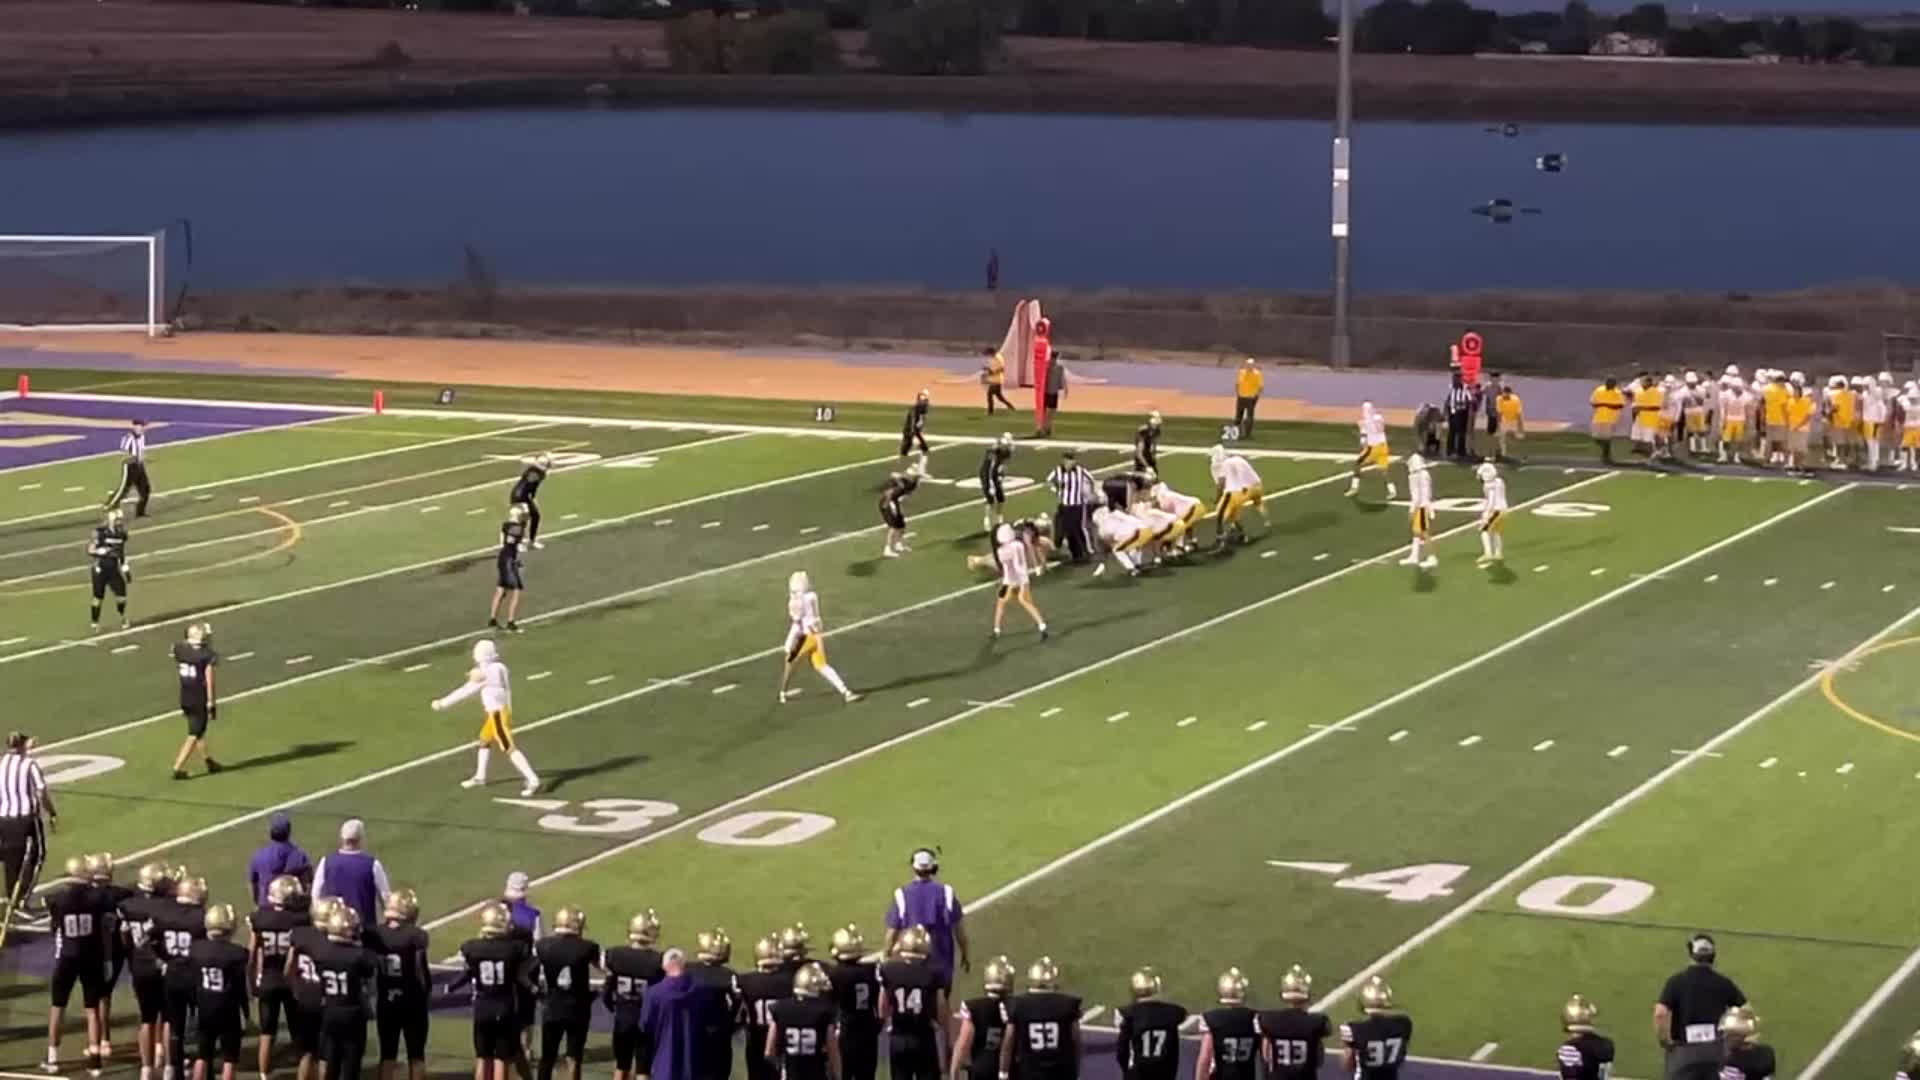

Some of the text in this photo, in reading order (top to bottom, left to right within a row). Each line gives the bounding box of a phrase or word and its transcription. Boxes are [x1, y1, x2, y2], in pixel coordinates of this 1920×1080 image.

[1221, 426, 1240, 440] 20
[322, 970, 348, 995] 31
[480, 960, 505, 986] 81
[556, 965, 573, 991] 4
[895, 987, 923, 1014] 14
[786, 1027, 817, 1054] 32
[1028, 1022, 1059, 1050] 53
[1141, 1030, 1167, 1058] 17
[1275, 1039, 1308, 1066] 33
[1366, 1037, 1402, 1067] 37
